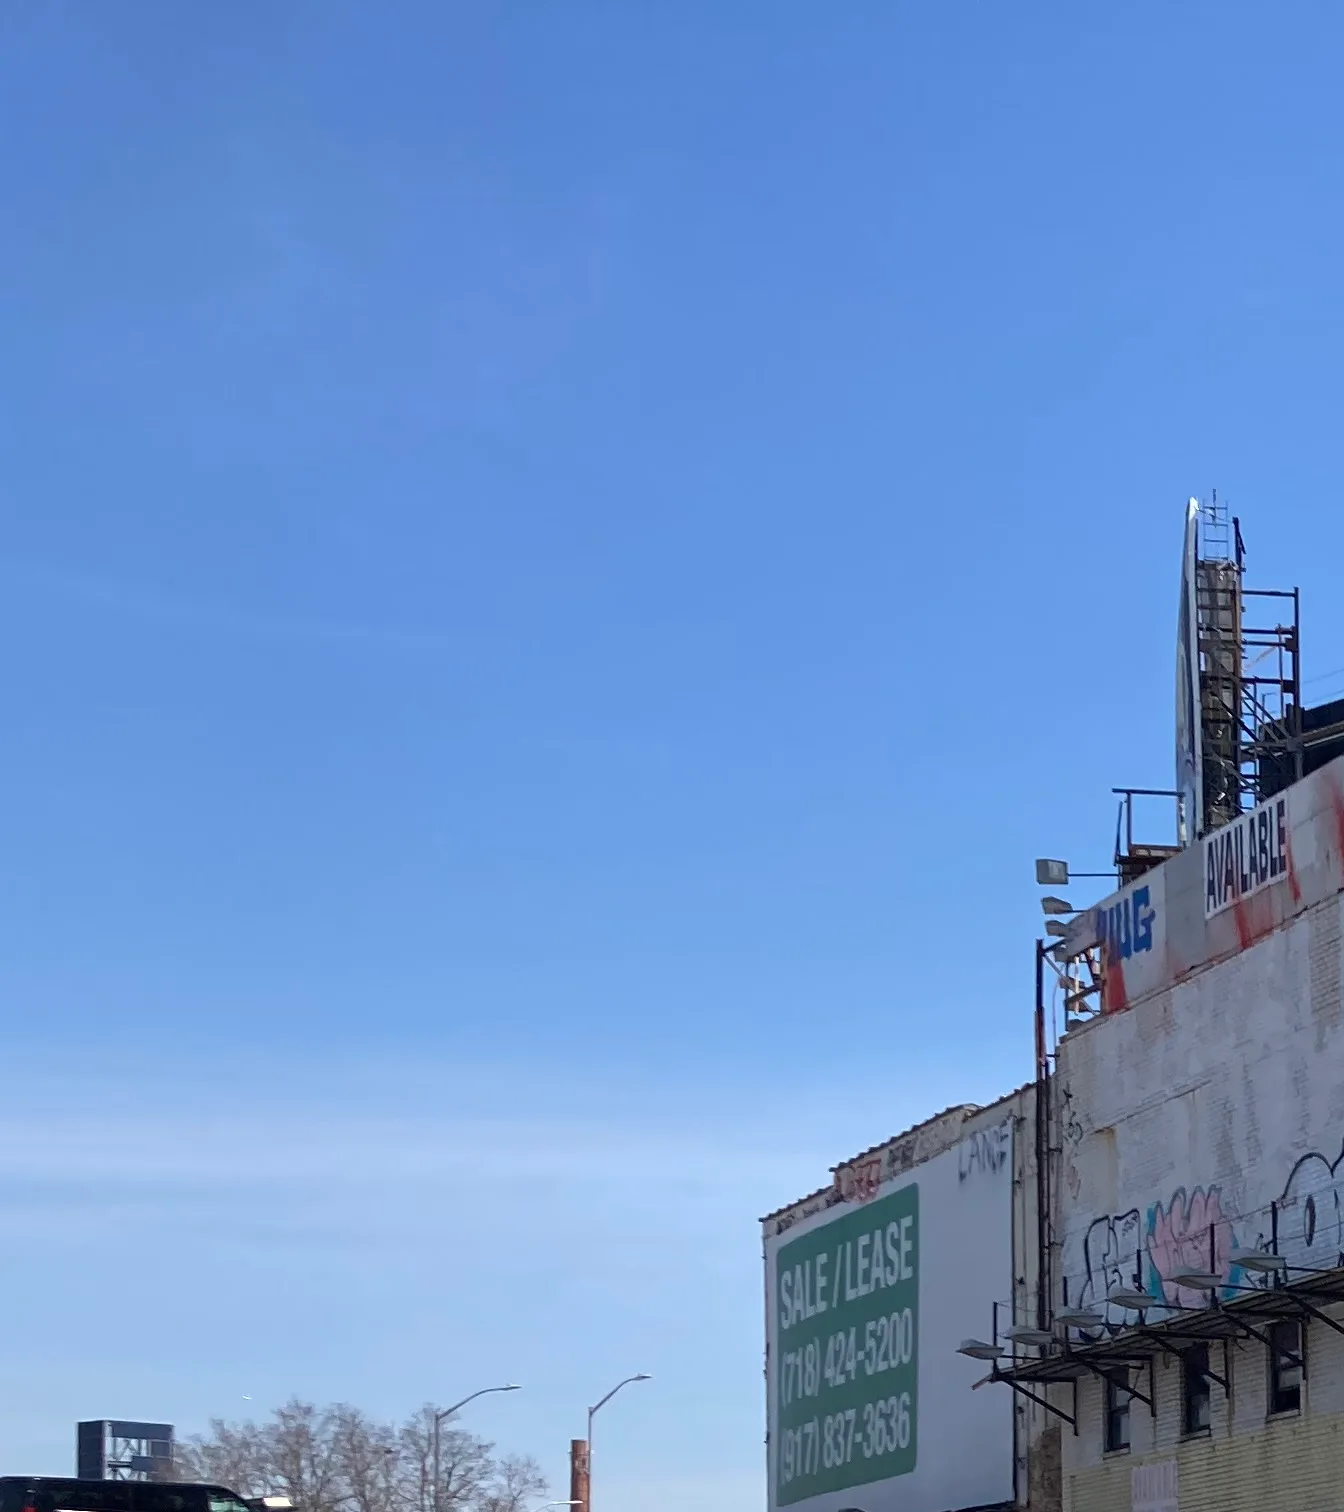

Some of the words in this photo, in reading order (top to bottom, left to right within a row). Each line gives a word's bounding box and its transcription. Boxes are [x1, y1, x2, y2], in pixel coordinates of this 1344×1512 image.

[1206, 800, 1287, 912] AVAILABLE
[781, 1252, 828, 1330] SALE
[845, 1215, 913, 1301] LEASE
[781, 1336, 820, 1407] (718)
[824, 1307, 912, 1388] 424-5200
[780, 1416, 819, 1485] (917)
[822, 1392, 910, 1468] 837-3636
